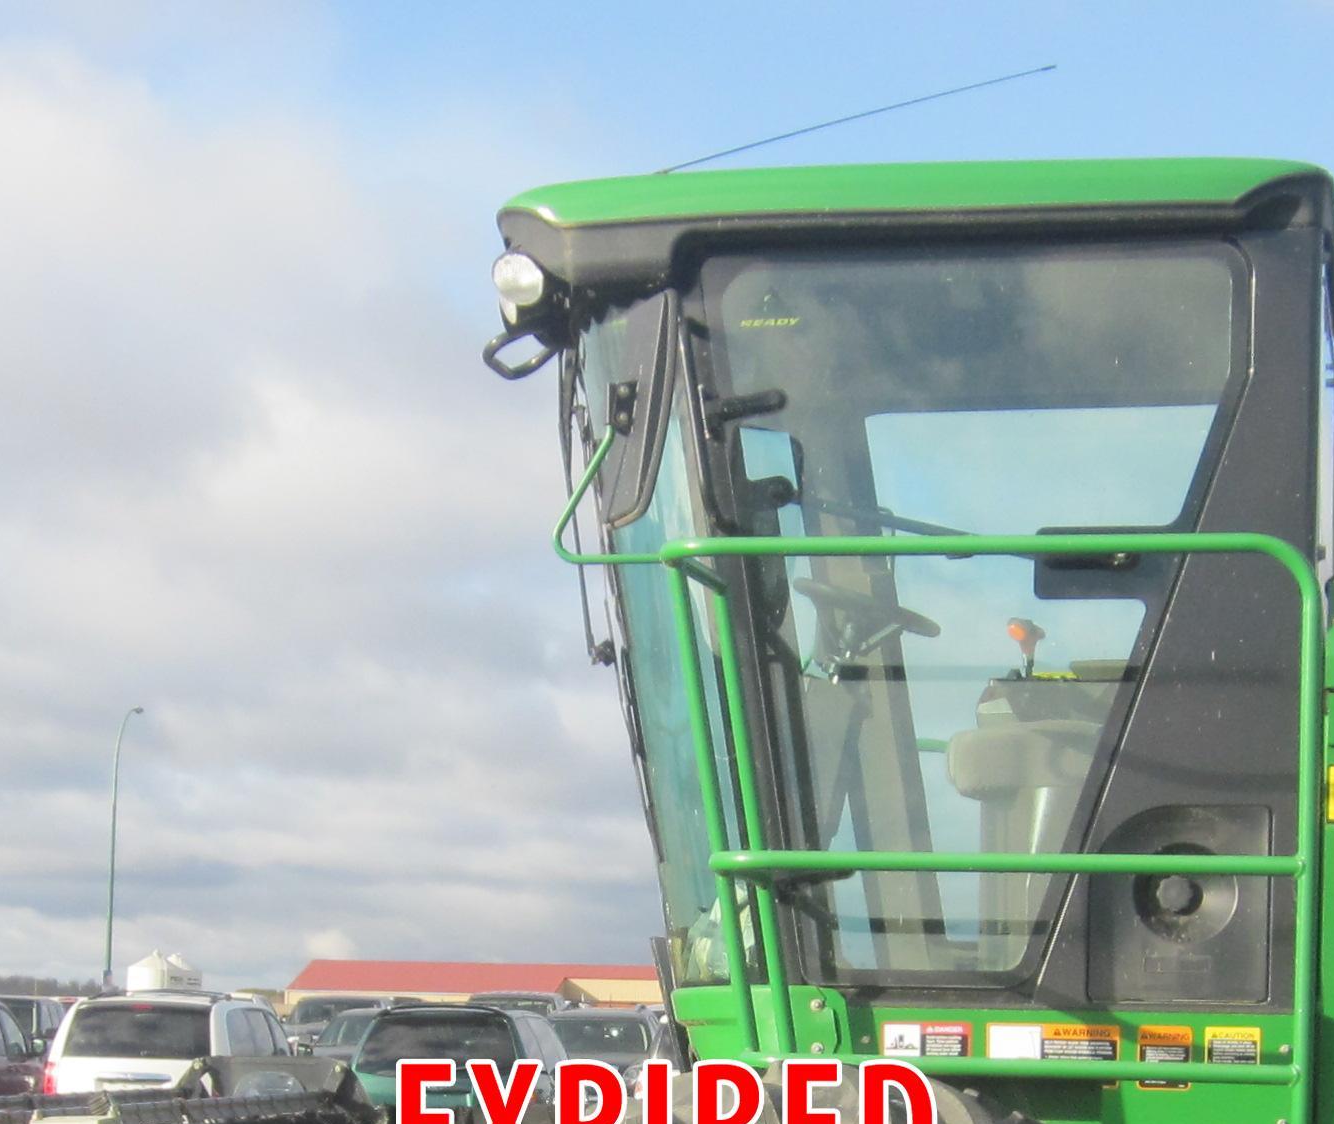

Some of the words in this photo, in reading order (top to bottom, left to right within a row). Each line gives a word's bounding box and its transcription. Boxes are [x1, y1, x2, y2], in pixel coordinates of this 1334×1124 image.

[1062, 1028, 1111, 1038] WARNING
[1148, 1031, 1191, 1042] WARNING
[1217, 1031, 1255, 1040] CAUTION
